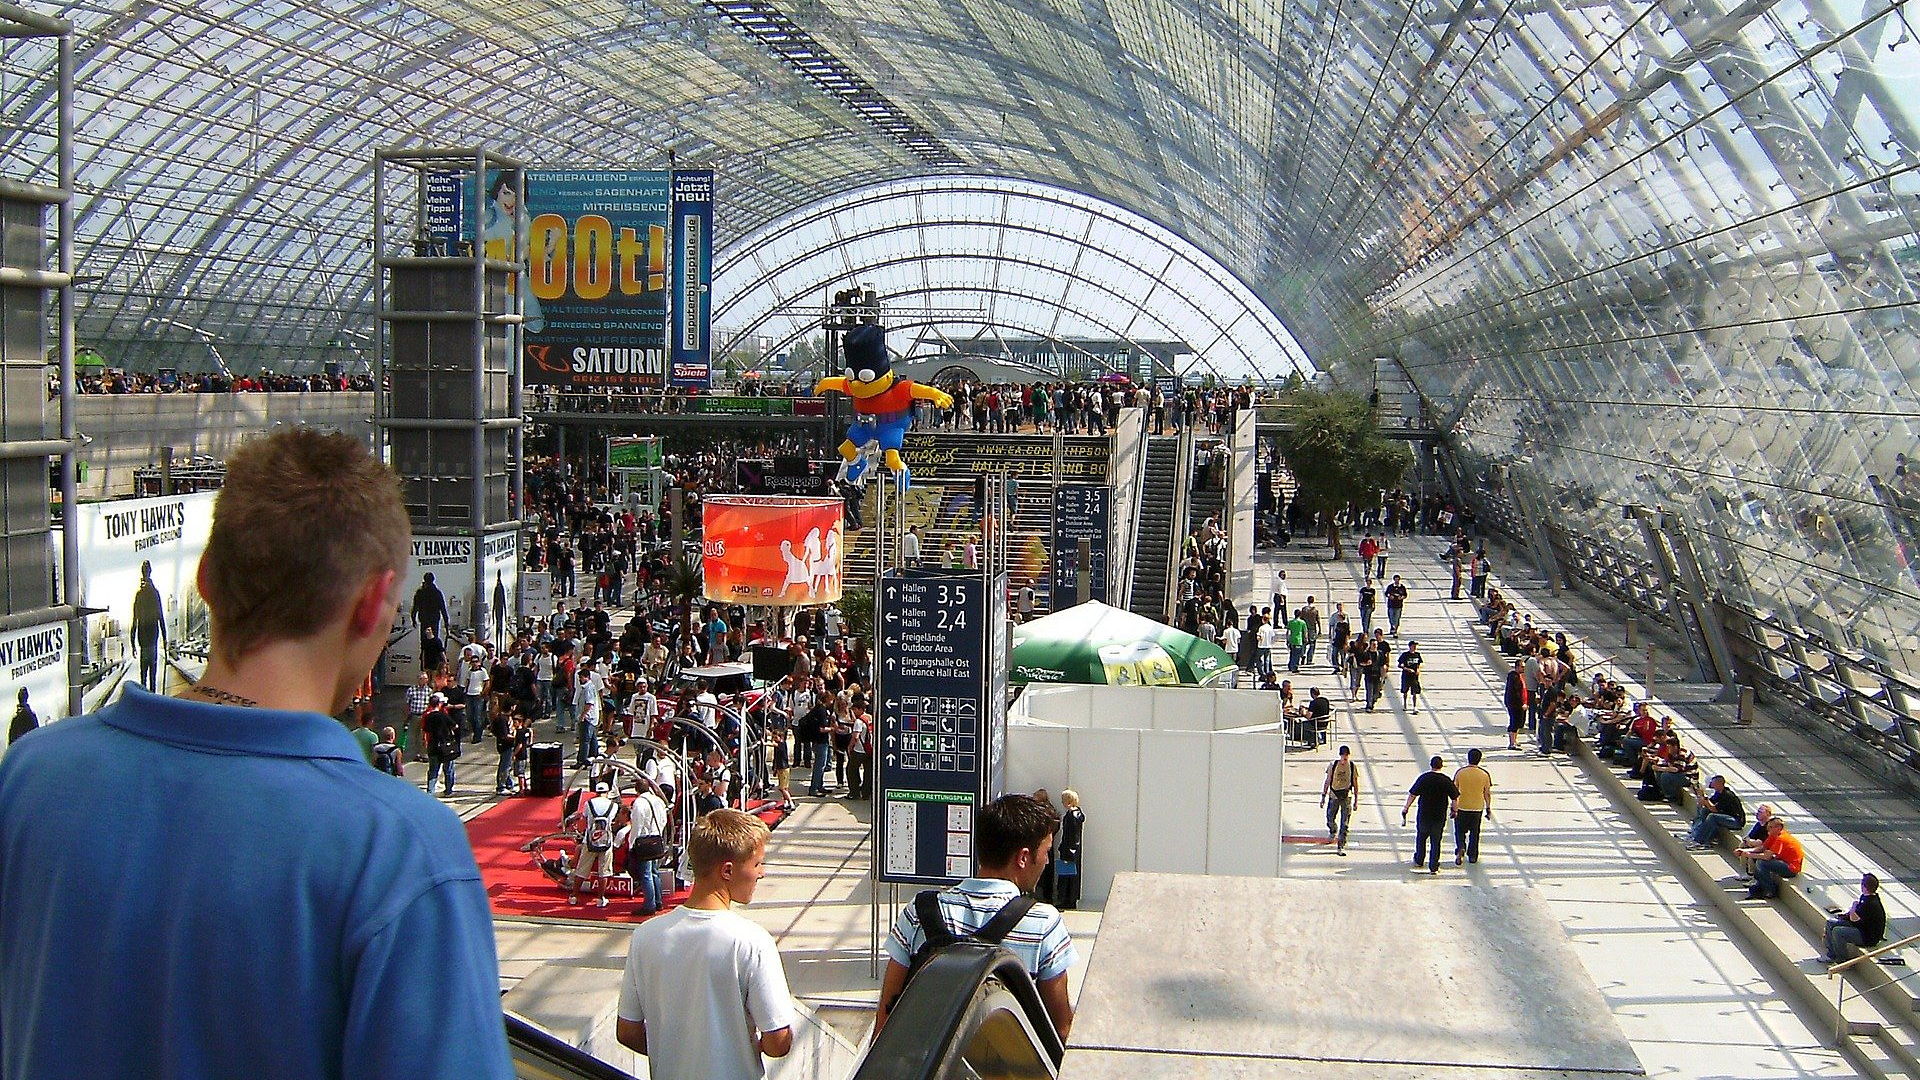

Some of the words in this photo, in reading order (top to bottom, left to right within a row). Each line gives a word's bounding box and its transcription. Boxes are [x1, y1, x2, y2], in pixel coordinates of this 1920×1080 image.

[527, 173, 627, 182] ATEMBERAUBEND
[595, 188, 664, 196] SAGENHAFT
[675, 182, 710, 192] Jetzt
[675, 192, 710, 202] neu!
[583, 203, 668, 212] MITREISSEND
[430, 225, 457, 234] piele!
[686, 218, 698, 346] computerbildspiele.de
[550, 321, 601, 329] BEWEGEND
[603, 321, 663, 330] SPANNEND
[572, 347, 662, 374] SATURN
[674, 368, 707, 378] Spiele
[572, 375, 601, 383] GEIZ
[605, 375, 624, 383] IST
[629, 376, 662, 384] GEIL!
[1084, 490, 1101, 503] 3,5
[1084, 503, 1101, 515] 2,4
[104, 510, 137, 540] TONY
[140, 502, 184, 533] HAWK'S
[424, 540, 471, 556] HAWK'S
[731, 585, 751, 594] AMD
[902, 583, 927, 593] Hallen
[937, 585, 967, 607] 3,5
[902, 594, 921, 603] Halls
[901, 608, 927, 617] Hallen
[937, 610, 967, 632] 2,4
[901, 618, 921, 628] Halls
[901, 632, 946, 643] Freigelände
[17, 627, 63, 661] HAWK'S
[901, 643, 933, 653] Outdoor
[934, 644, 953, 653] Area
[901, 657, 954, 668] Eingangshalle
[955, 658, 970, 668] Ost
[901, 667, 935, 677] Entrance
[936, 668, 952, 677] Hall
[953, 669, 970, 678] East
[887, 791, 912, 799] FLUCHT-
[925, 793, 973, 801] RETTUNGSPLAN
